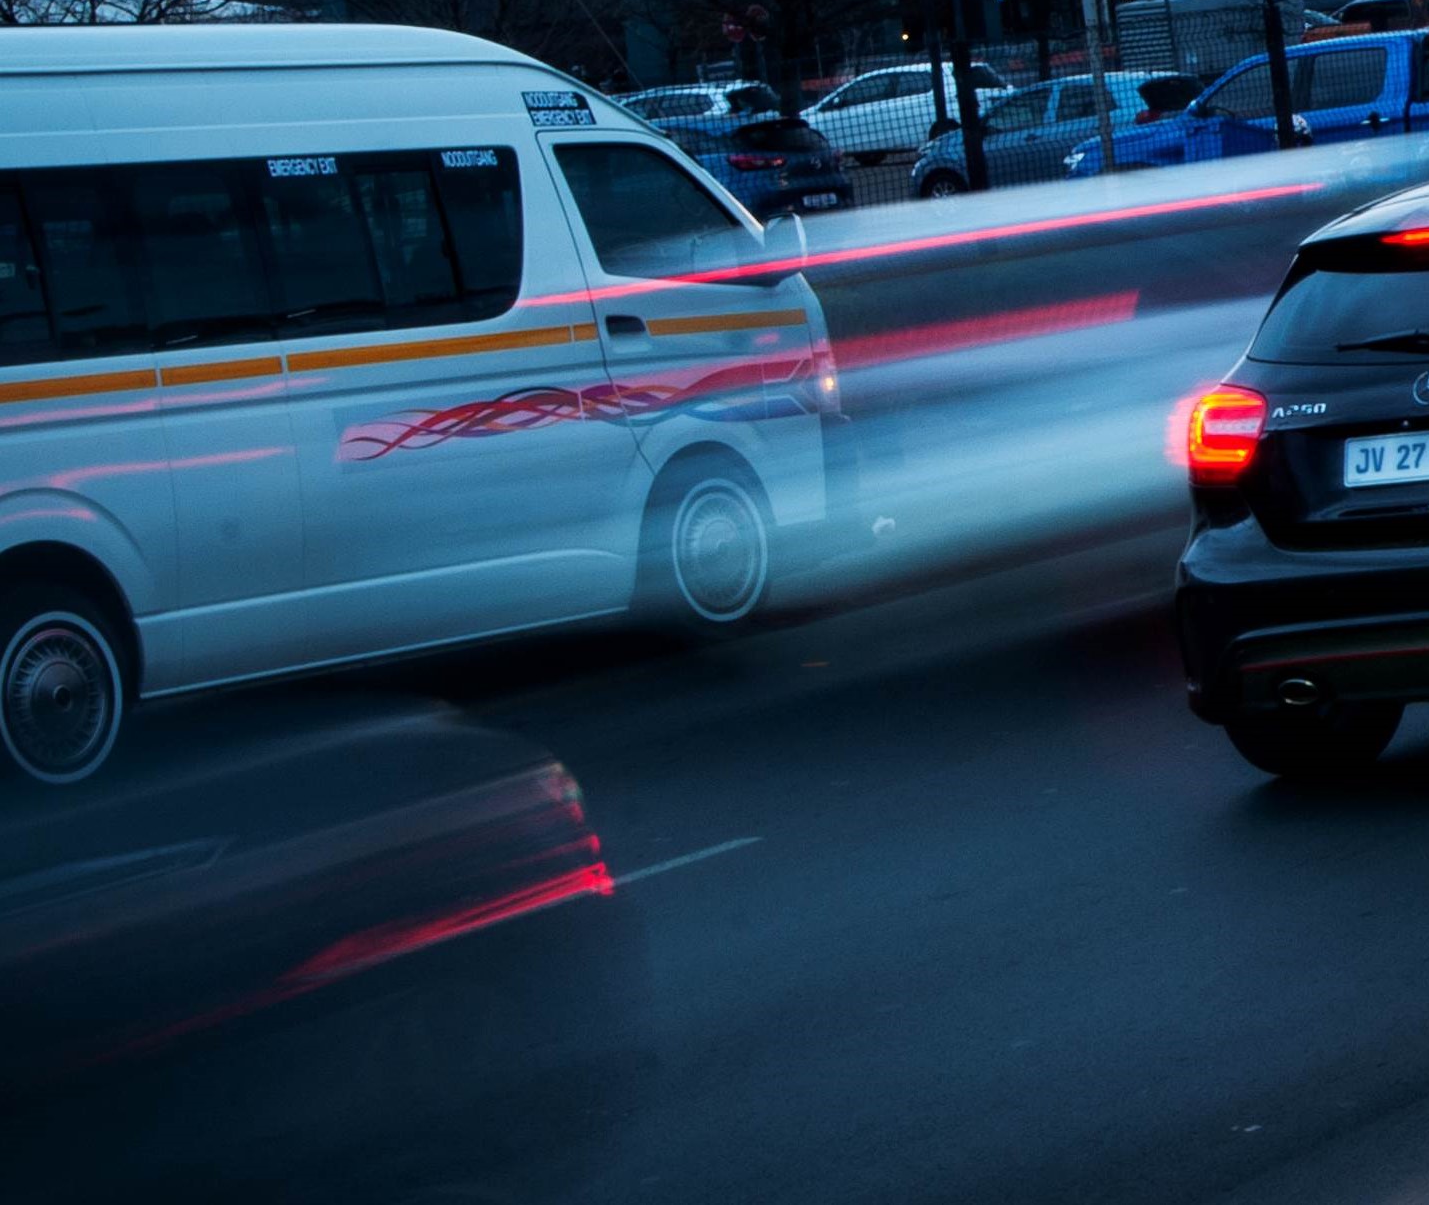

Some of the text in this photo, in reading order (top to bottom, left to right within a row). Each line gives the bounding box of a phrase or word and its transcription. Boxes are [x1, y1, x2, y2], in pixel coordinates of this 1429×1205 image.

[530, 109, 577, 125] EMERGENCY
[267, 156, 338, 177] EMERGENCY EXIT
[1355, 447, 1385, 474] JV
[1397, 442, 1426, 471] 27
